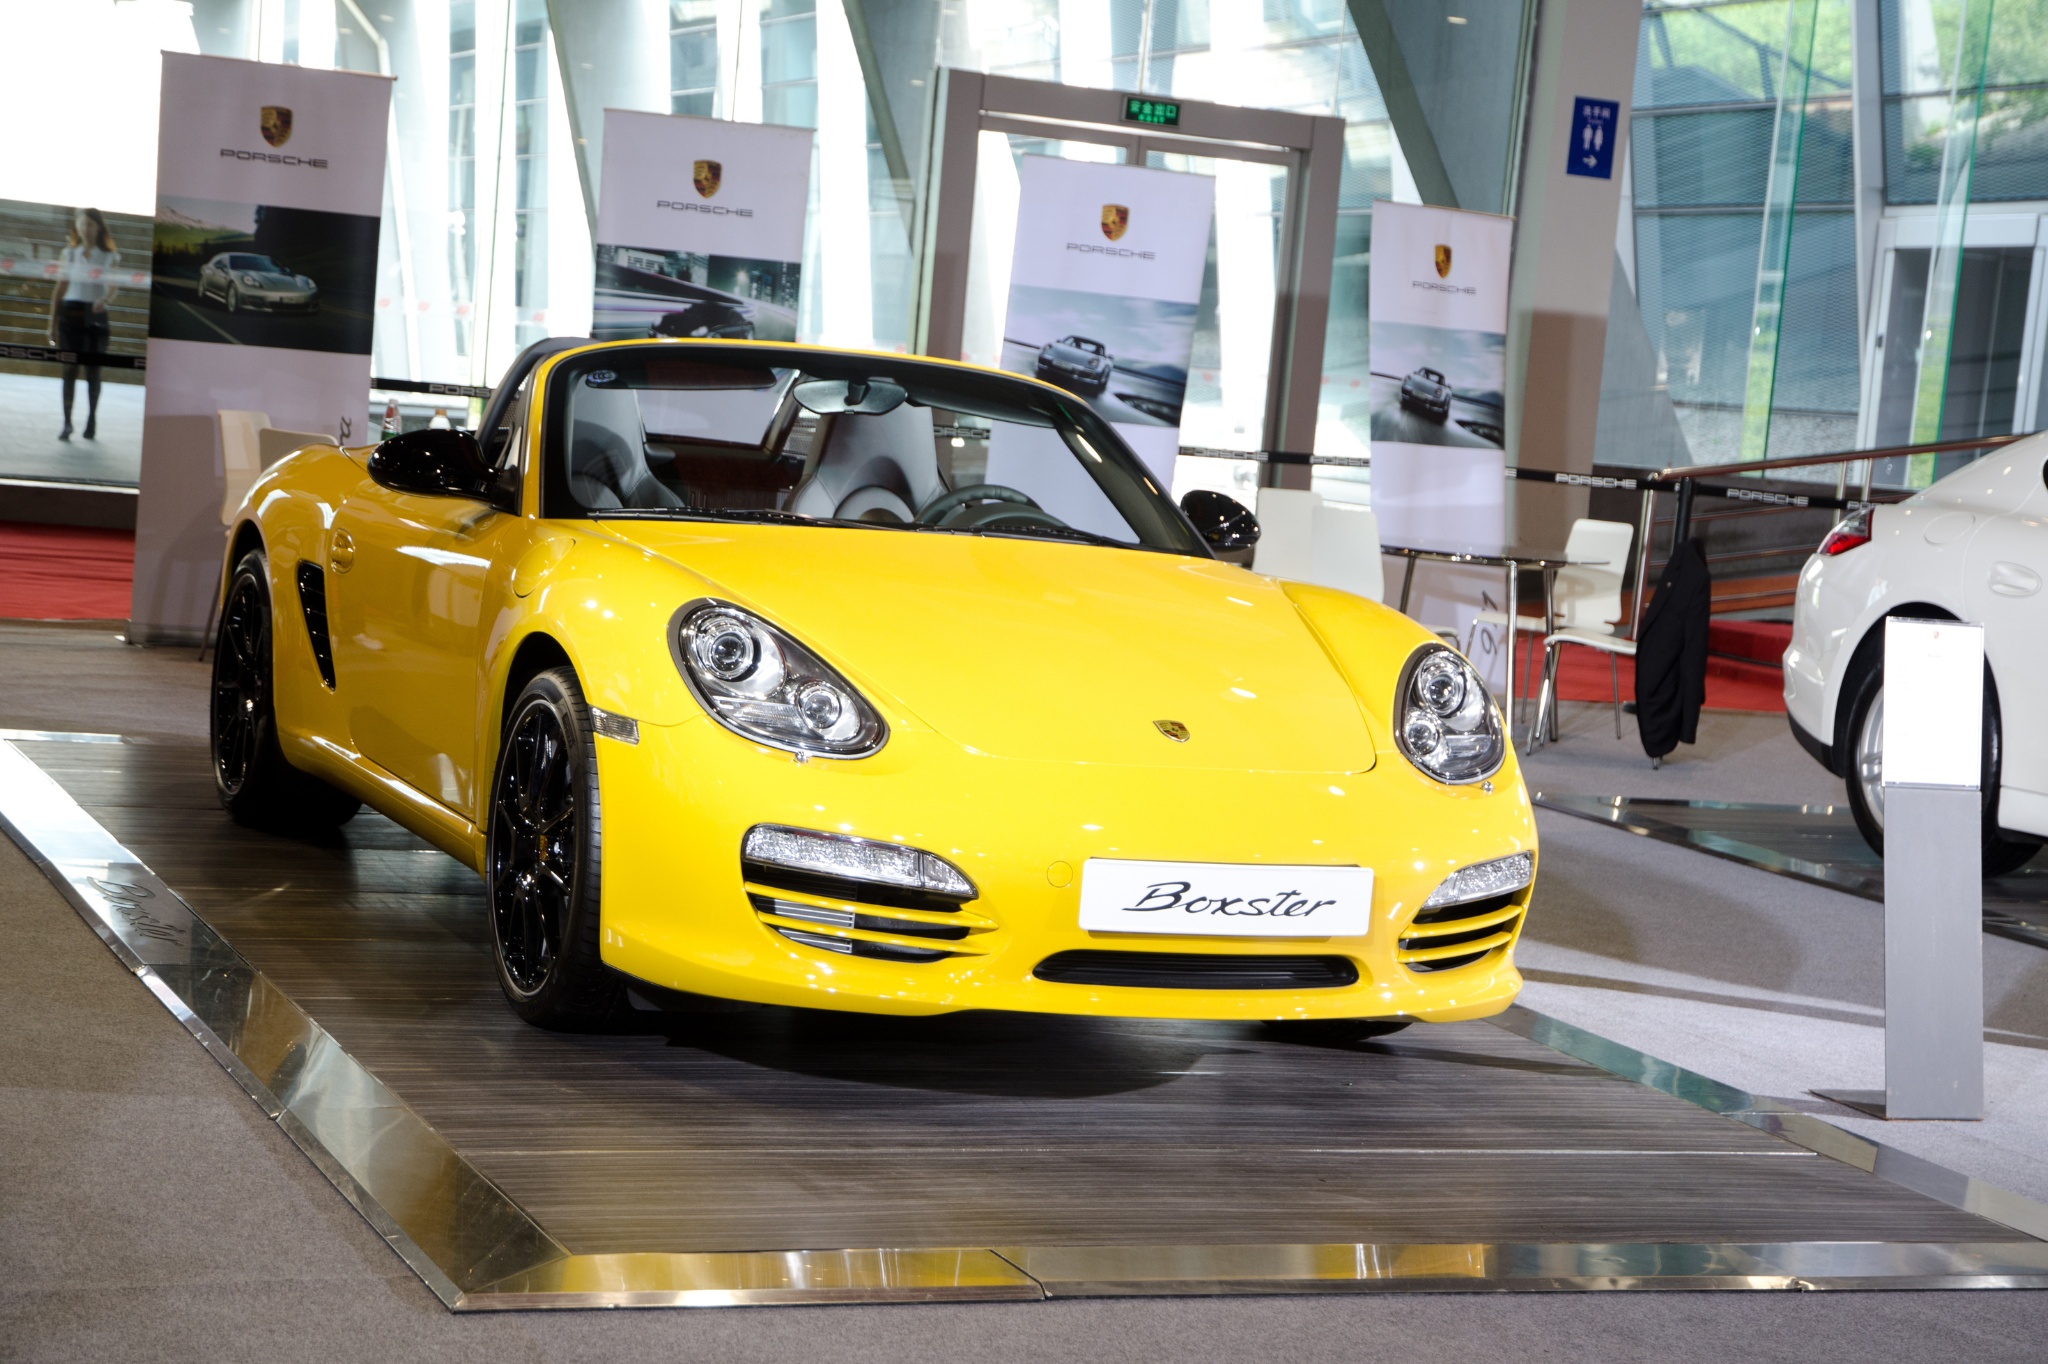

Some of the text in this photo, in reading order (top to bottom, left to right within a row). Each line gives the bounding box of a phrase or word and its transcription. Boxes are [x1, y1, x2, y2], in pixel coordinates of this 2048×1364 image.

[220, 148, 329, 169] PORSCHE
[657, 200, 753, 218] PORSCHE
[1066, 242, 1155, 260] PORSCHE
[1412, 280, 1476, 295] PORSCHE
[1180, 446, 1269, 461] PORSCHE
[1555, 473, 1637, 489] PORSCHE
[1727, 488, 1809, 507] PORSCHE
[1481, 590, 1499, 656] 91
[1121, 881, 1337, 917] Boxster
